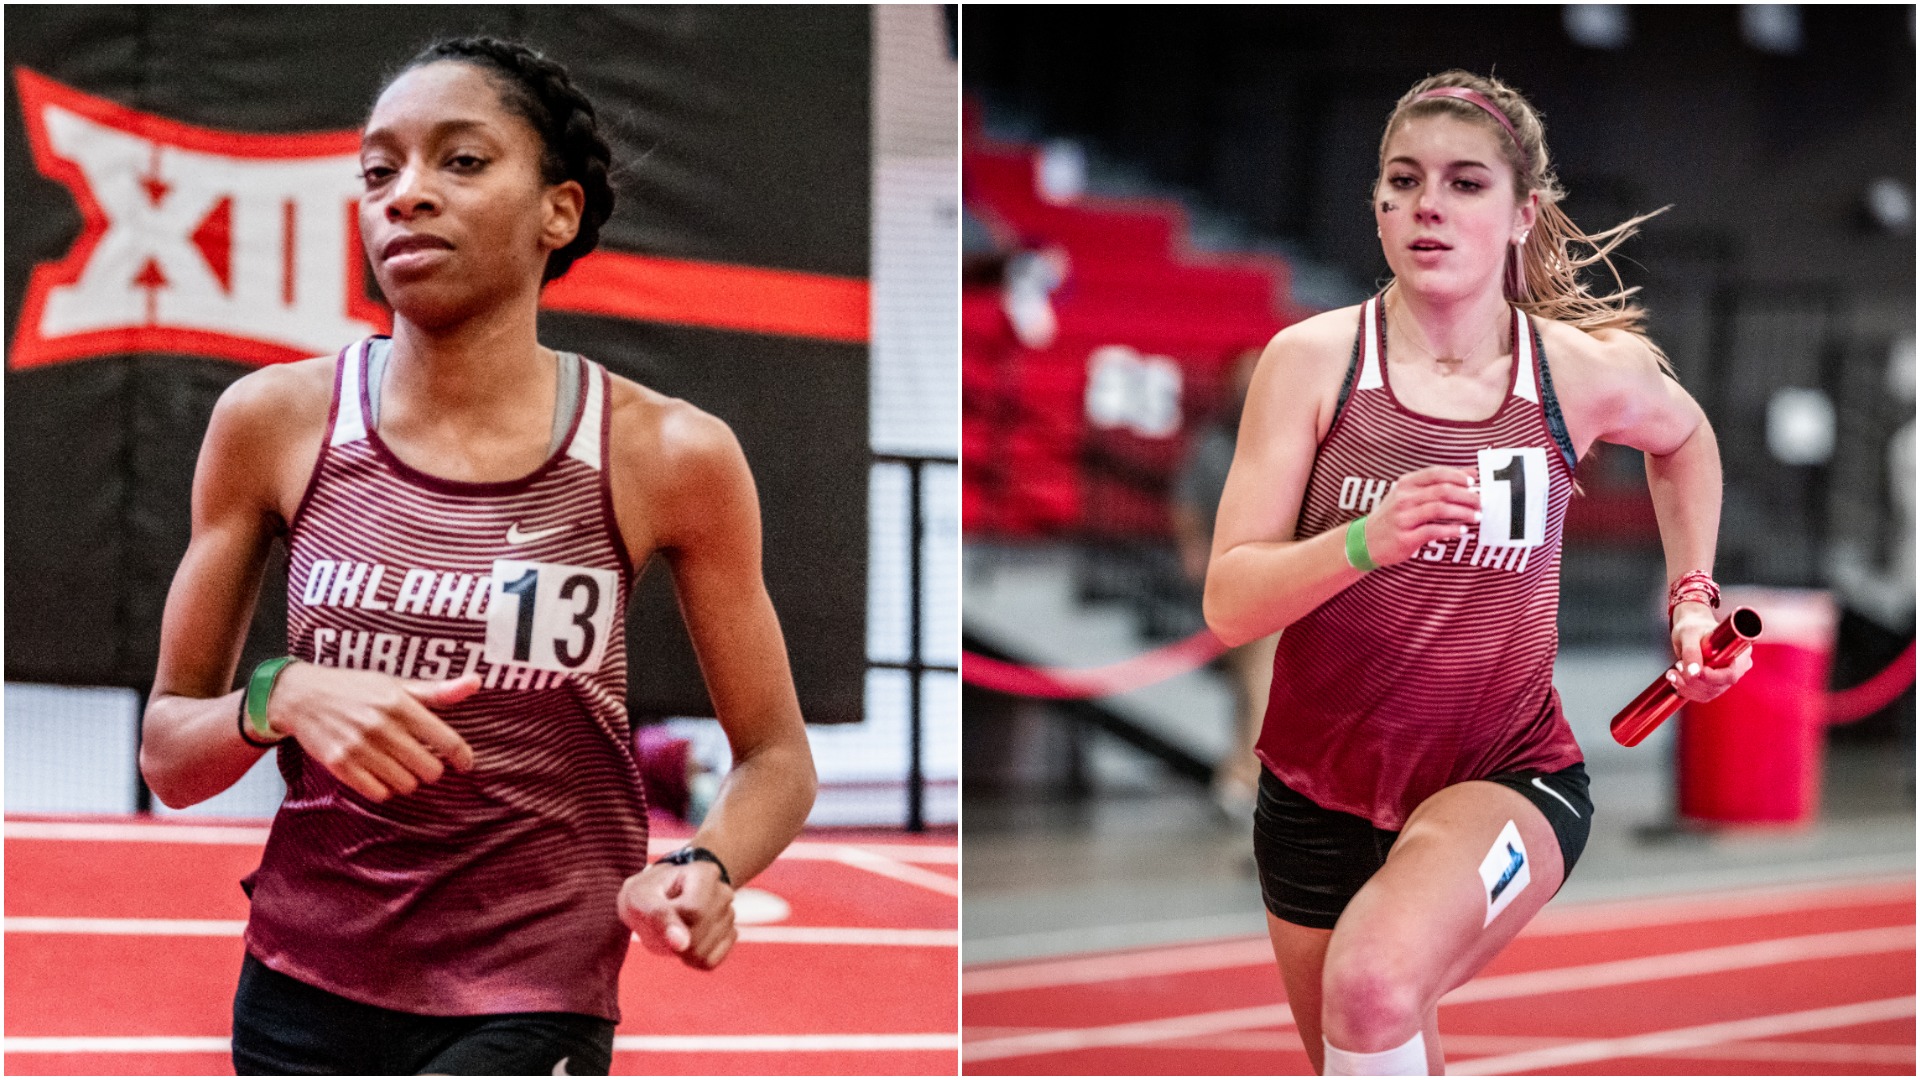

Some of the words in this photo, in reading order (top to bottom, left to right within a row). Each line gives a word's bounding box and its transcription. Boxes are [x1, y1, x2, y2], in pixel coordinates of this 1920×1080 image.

[40, 103, 363, 354] XII
[1493, 455, 1526, 541] 1
[303, 559, 493, 621] OKLAHO
[1411, 533, 1532, 574] STIAN
[503, 568, 600, 668] 13
